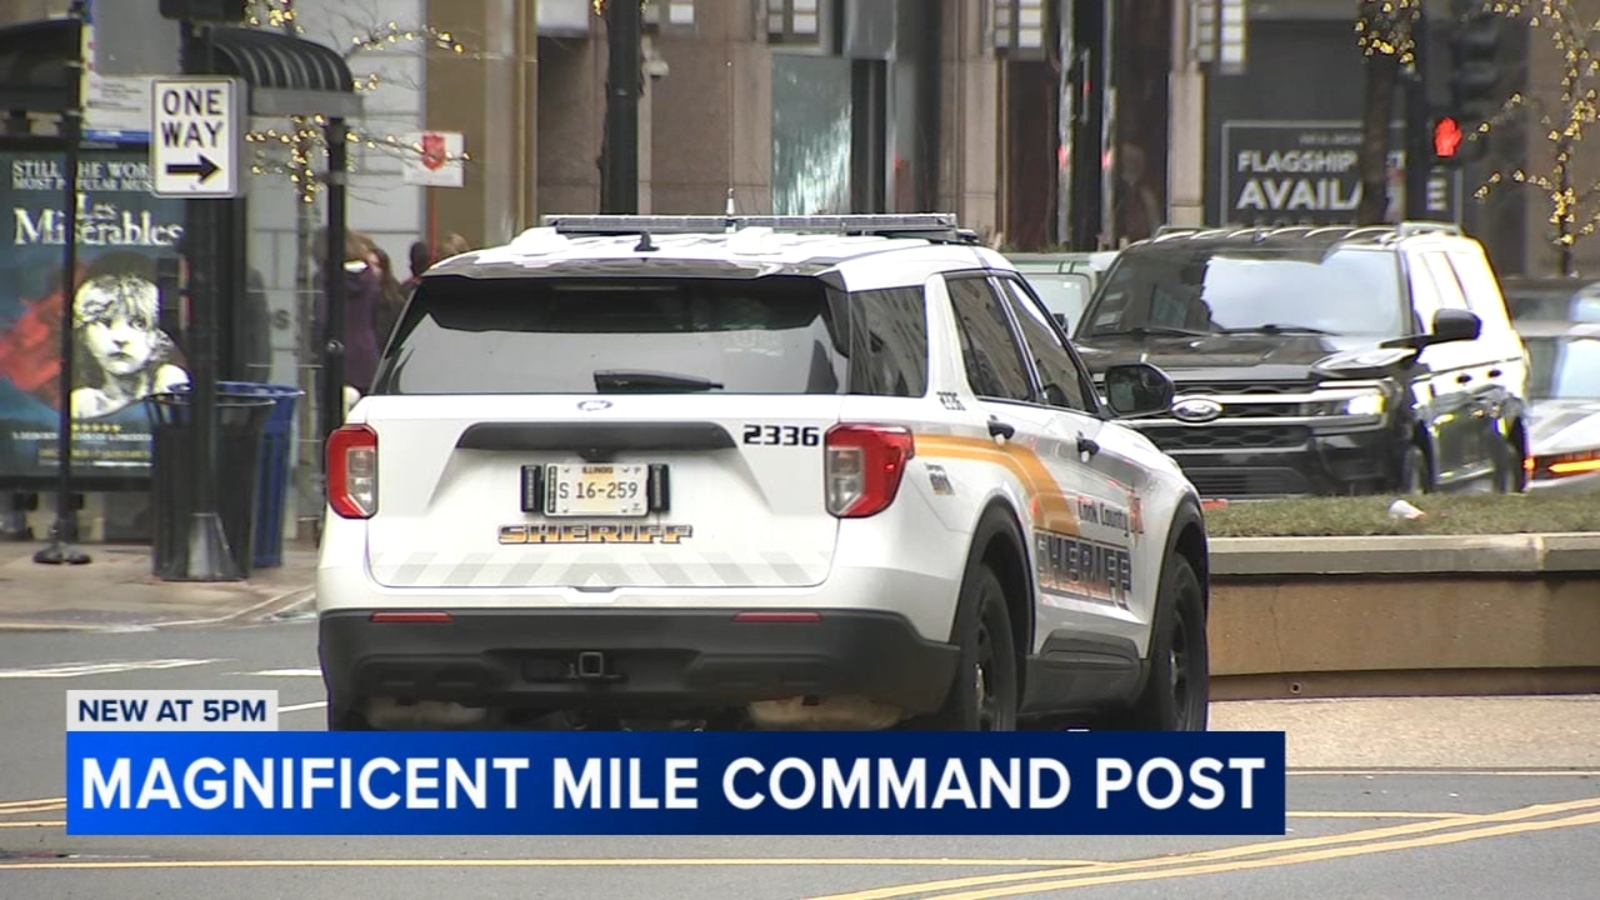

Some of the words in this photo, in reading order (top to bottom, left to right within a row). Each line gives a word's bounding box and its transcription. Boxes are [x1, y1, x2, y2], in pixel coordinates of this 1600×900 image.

[162, 89, 223, 116] ONE
[161, 122, 223, 148] WAY
[12, 160, 62, 178] STILL
[75, 160, 102, 178] HE
[1237, 151, 1358, 172] FLAGSHIP
[75, 191, 117, 221] Les
[743, 424, 820, 447] 2336
[559, 482, 570, 499] S
[576, 482, 639, 499] 16-259
[498, 523, 694, 545] SHERIFF
[1034, 531, 1133, 604] SHERIFF
